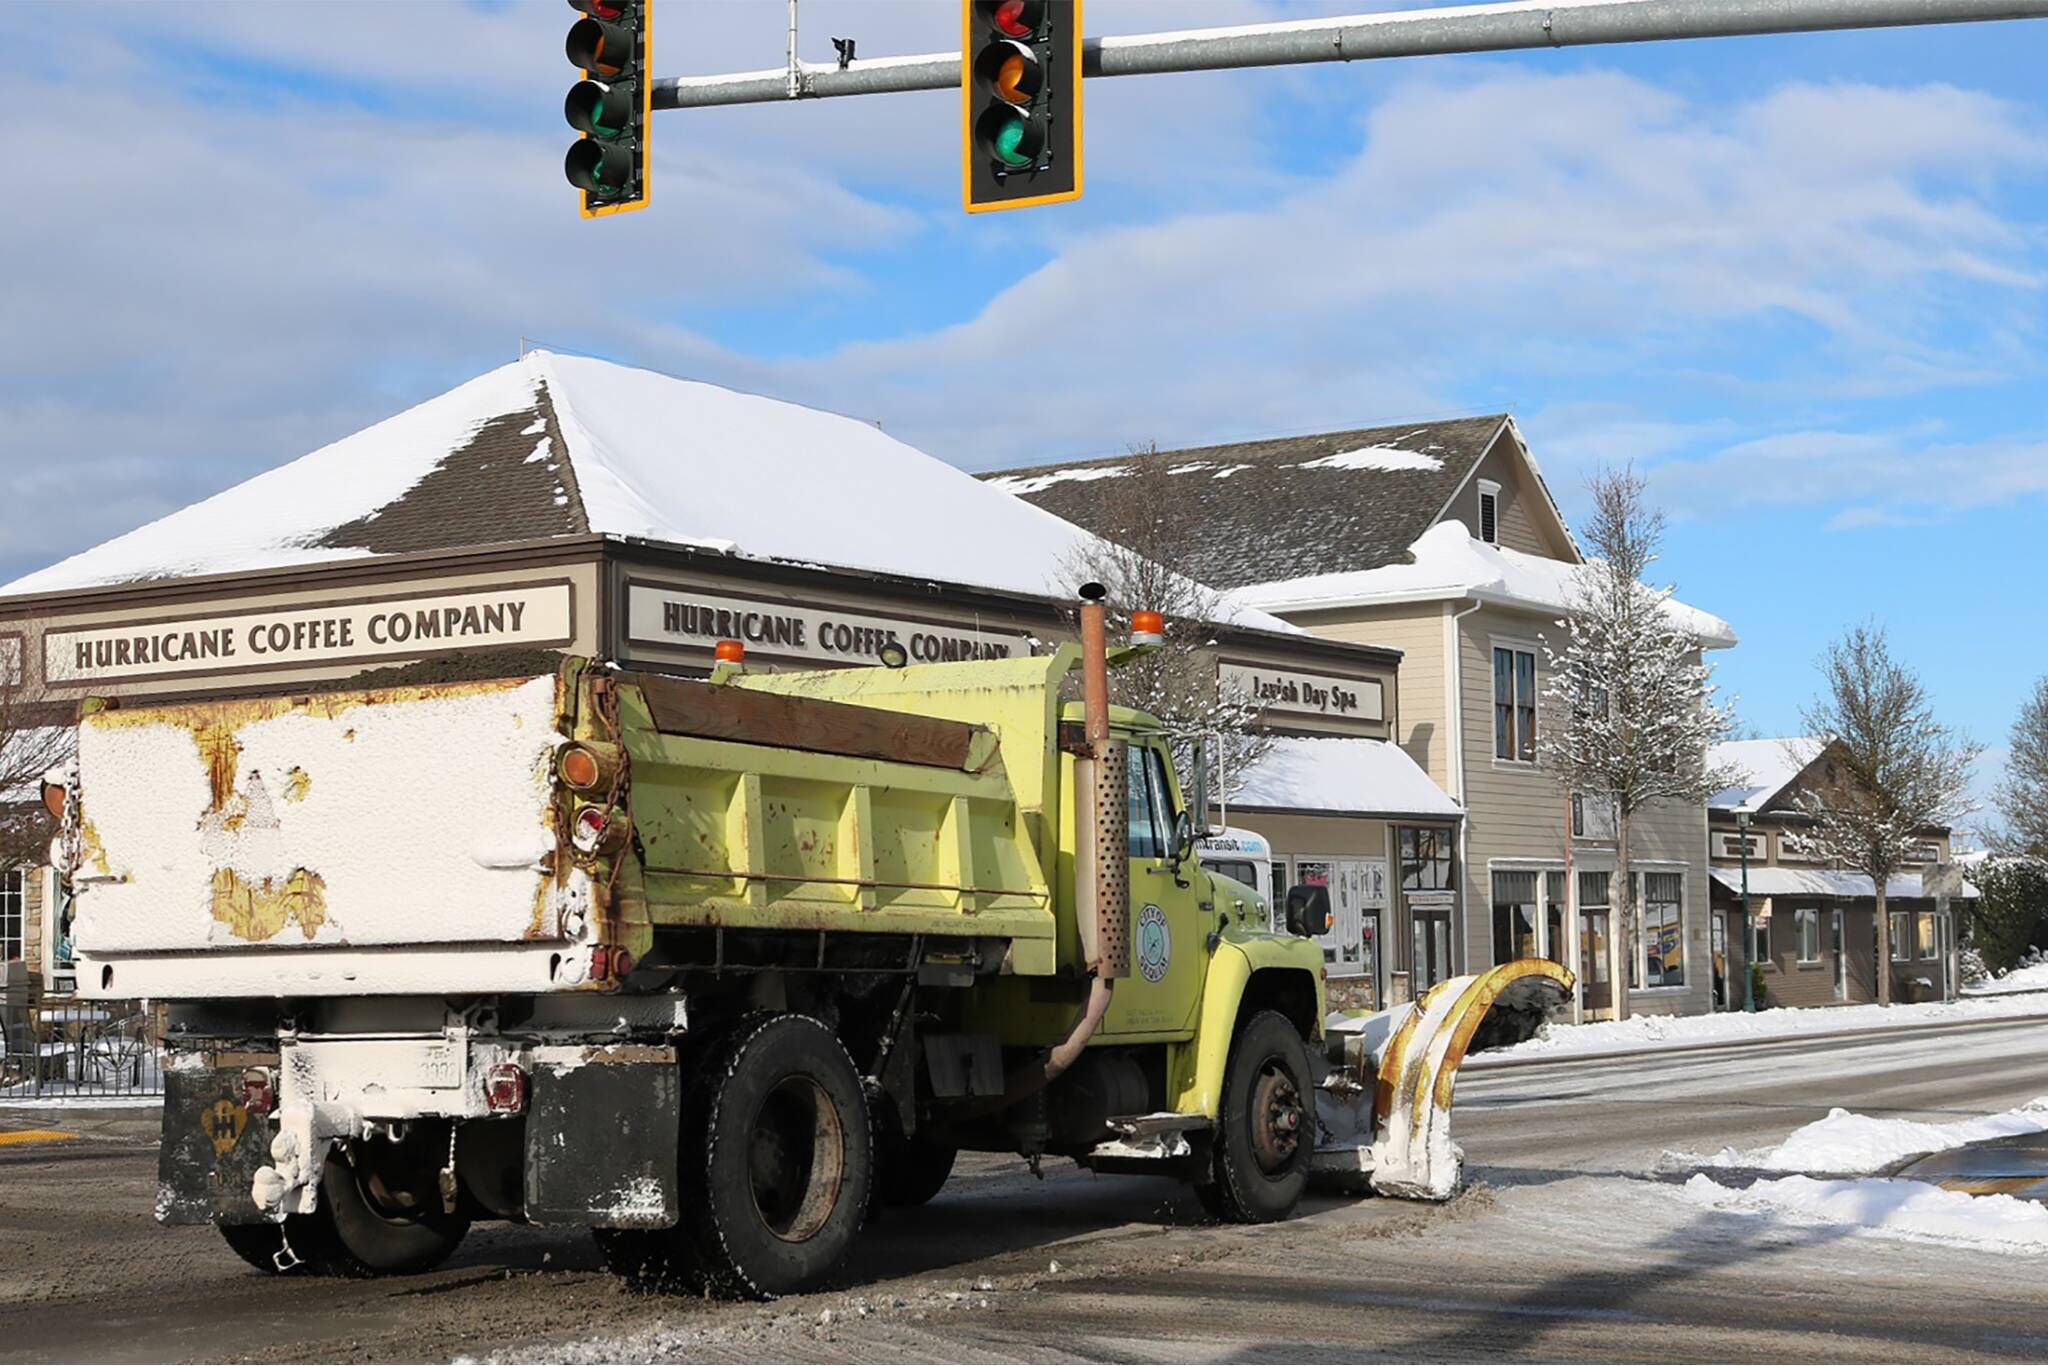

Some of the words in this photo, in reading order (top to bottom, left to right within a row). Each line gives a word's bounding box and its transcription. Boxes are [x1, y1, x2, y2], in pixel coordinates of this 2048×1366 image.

[75, 627, 236, 669] HURRICANE
[248, 618, 354, 654] COFFEE
[367, 602, 526, 645] COMPANY
[663, 601, 805, 647] HURRICANE
[910, 632, 1009, 662] COMPANY
[1253, 676, 1299, 703] Lavish
[1303, 682, 1328, 711] Day
[1332, 686, 1357, 712] Spa
[1140, 907, 1156, 927] CITY
[1156, 911, 1168, 926] OF
